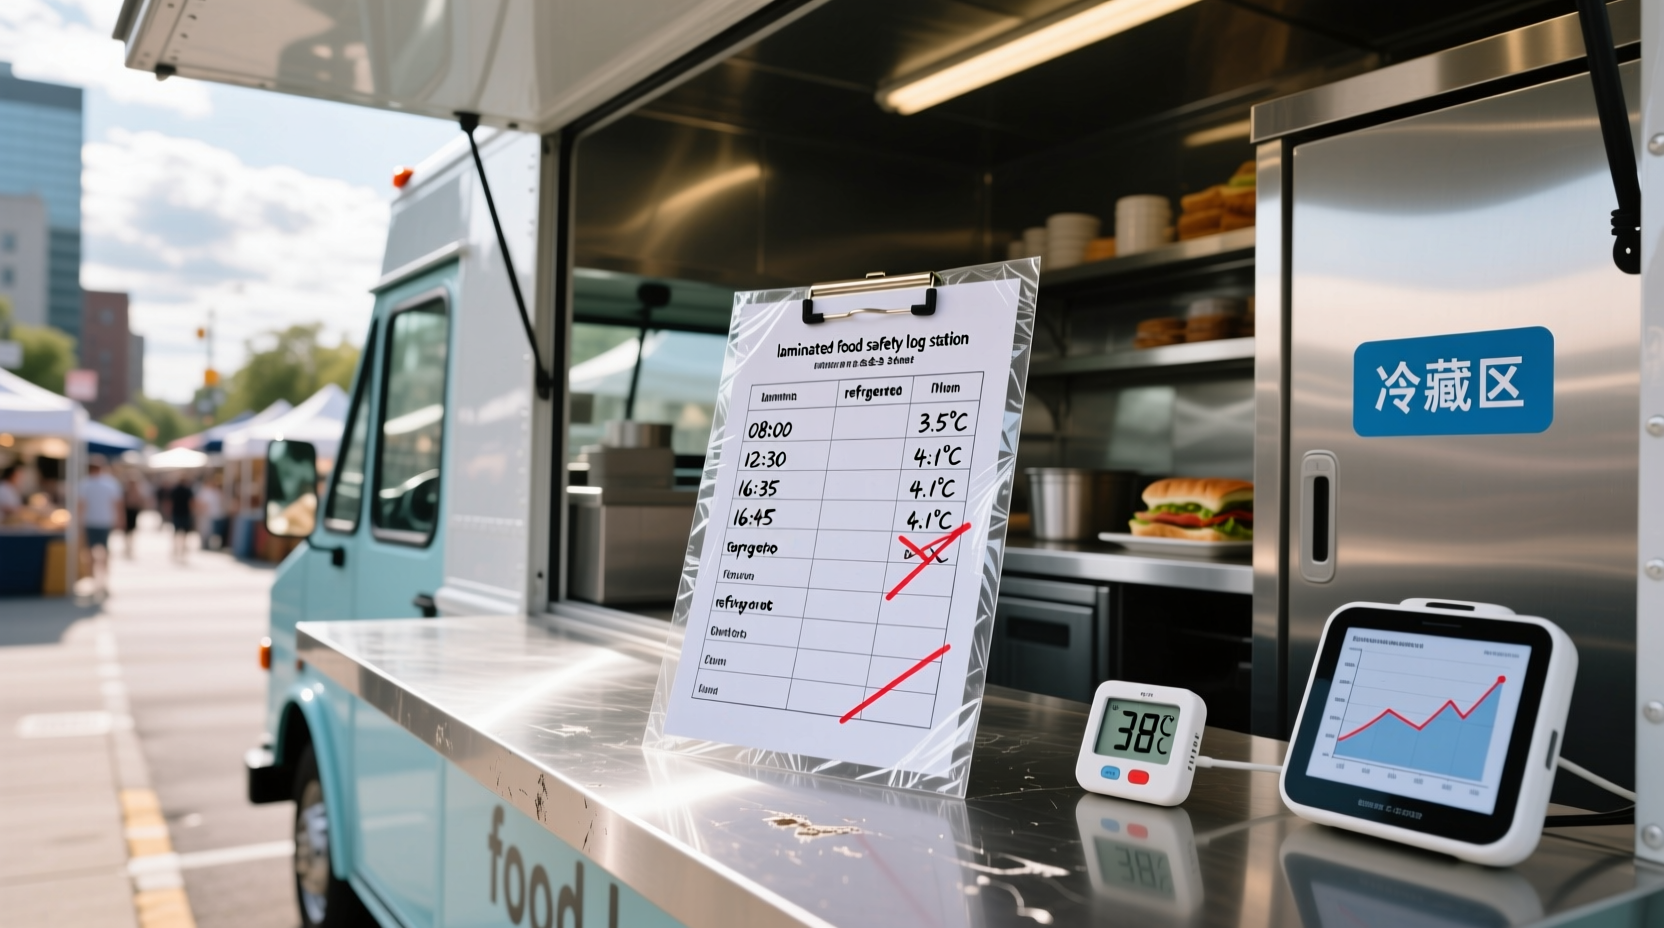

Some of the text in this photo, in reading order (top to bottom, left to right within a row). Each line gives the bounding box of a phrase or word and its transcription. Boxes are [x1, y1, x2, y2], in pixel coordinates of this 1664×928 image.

[777, 340, 834, 358] laminated
[837, 337, 863, 353] food
[866, 335, 903, 353] safety
[906, 334, 926, 352] log
[1375, 356, 1524, 415] 冷藏区
[748, 420, 793, 439] 08:00
[918, 410, 968, 433] 3.5°C
[744, 450, 787, 468] 12:30
[738, 479, 780, 497] 16:35
[909, 476, 955, 499] 4.1°C
[733, 507, 776, 527] 16:45
[906, 509, 952, 531] 4.1°C
[488, 804, 584, 928] food
